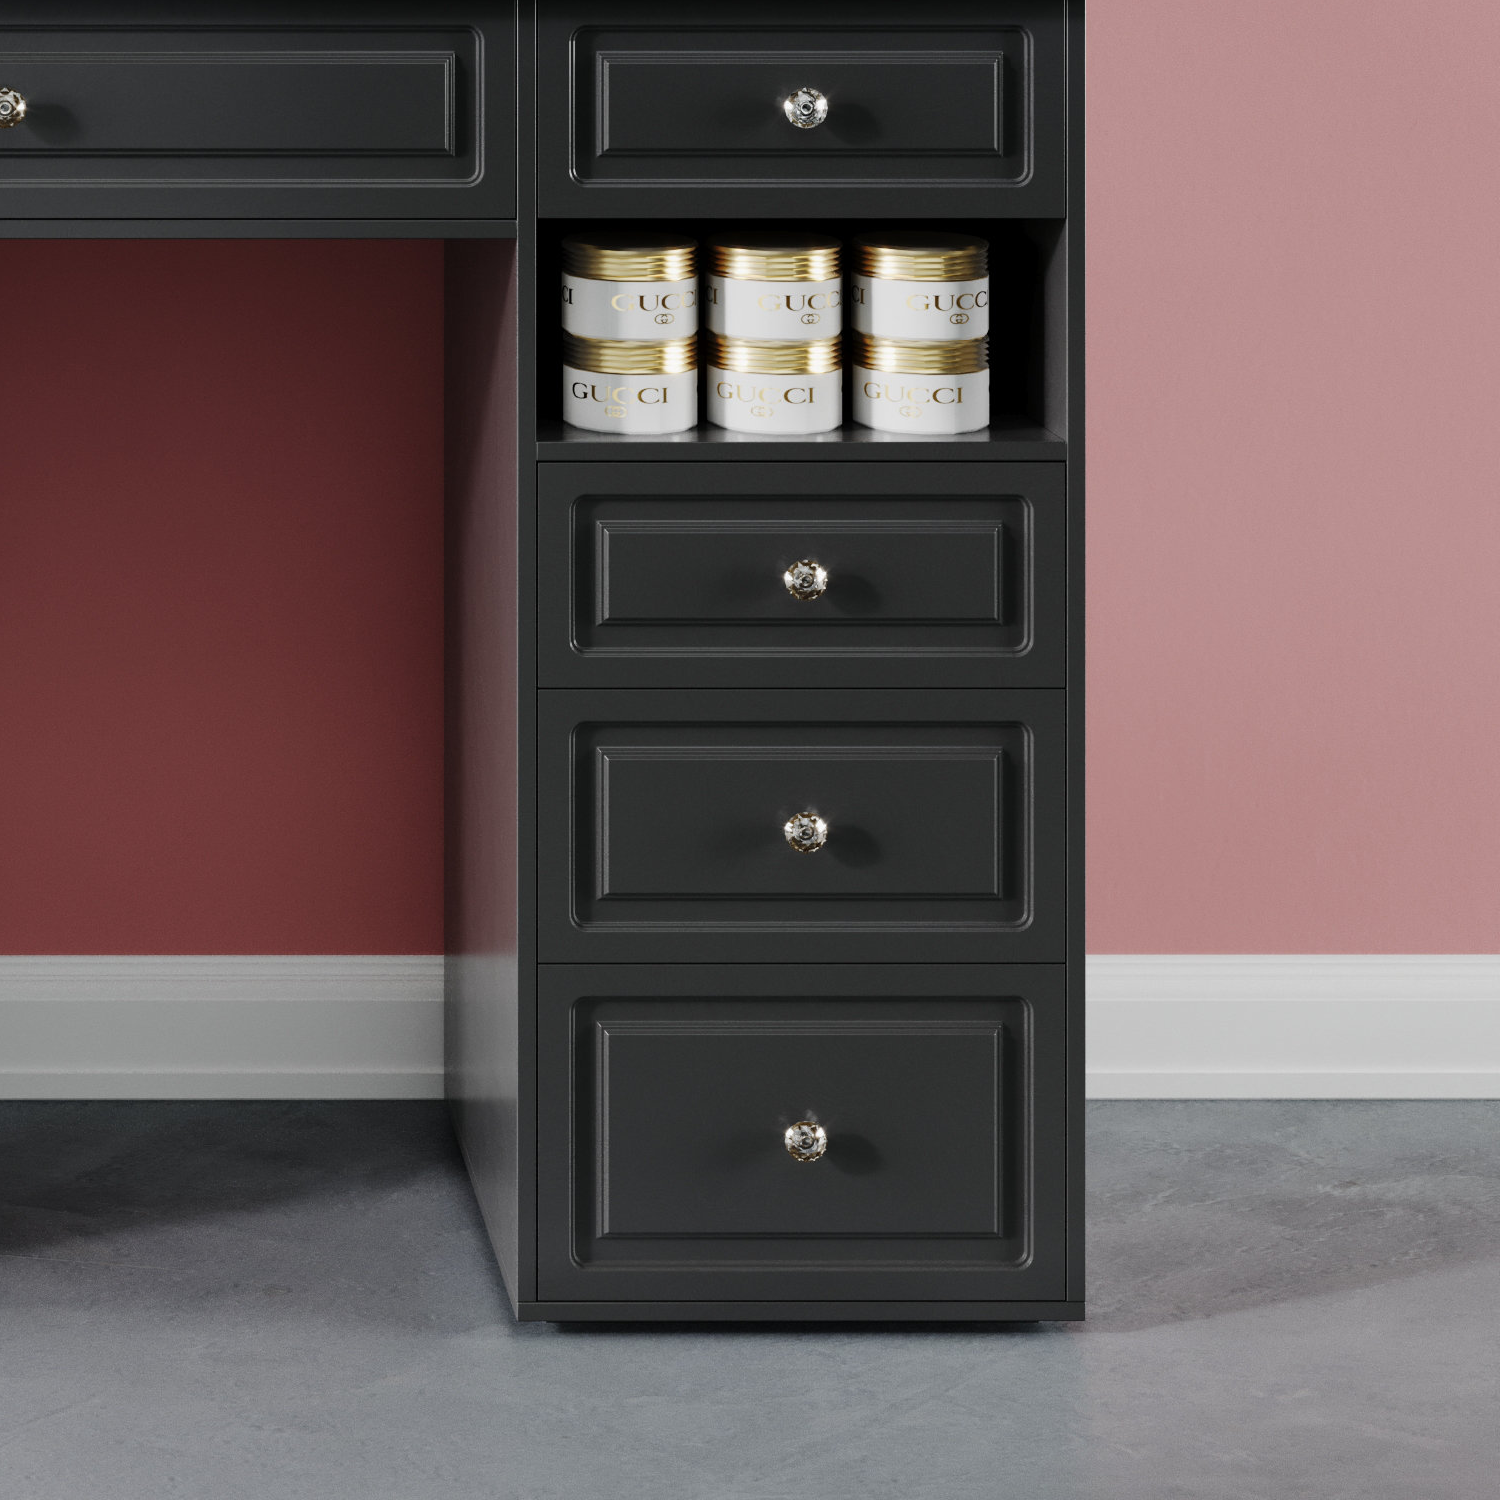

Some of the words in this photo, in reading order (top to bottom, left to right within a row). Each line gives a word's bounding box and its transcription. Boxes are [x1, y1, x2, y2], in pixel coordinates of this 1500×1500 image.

[906, 290, 988, 311] GUCC
[572, 382, 668, 404] GUCCI
[717, 381, 815, 404] GUCCI
[863, 381, 964, 404] GUCCI
